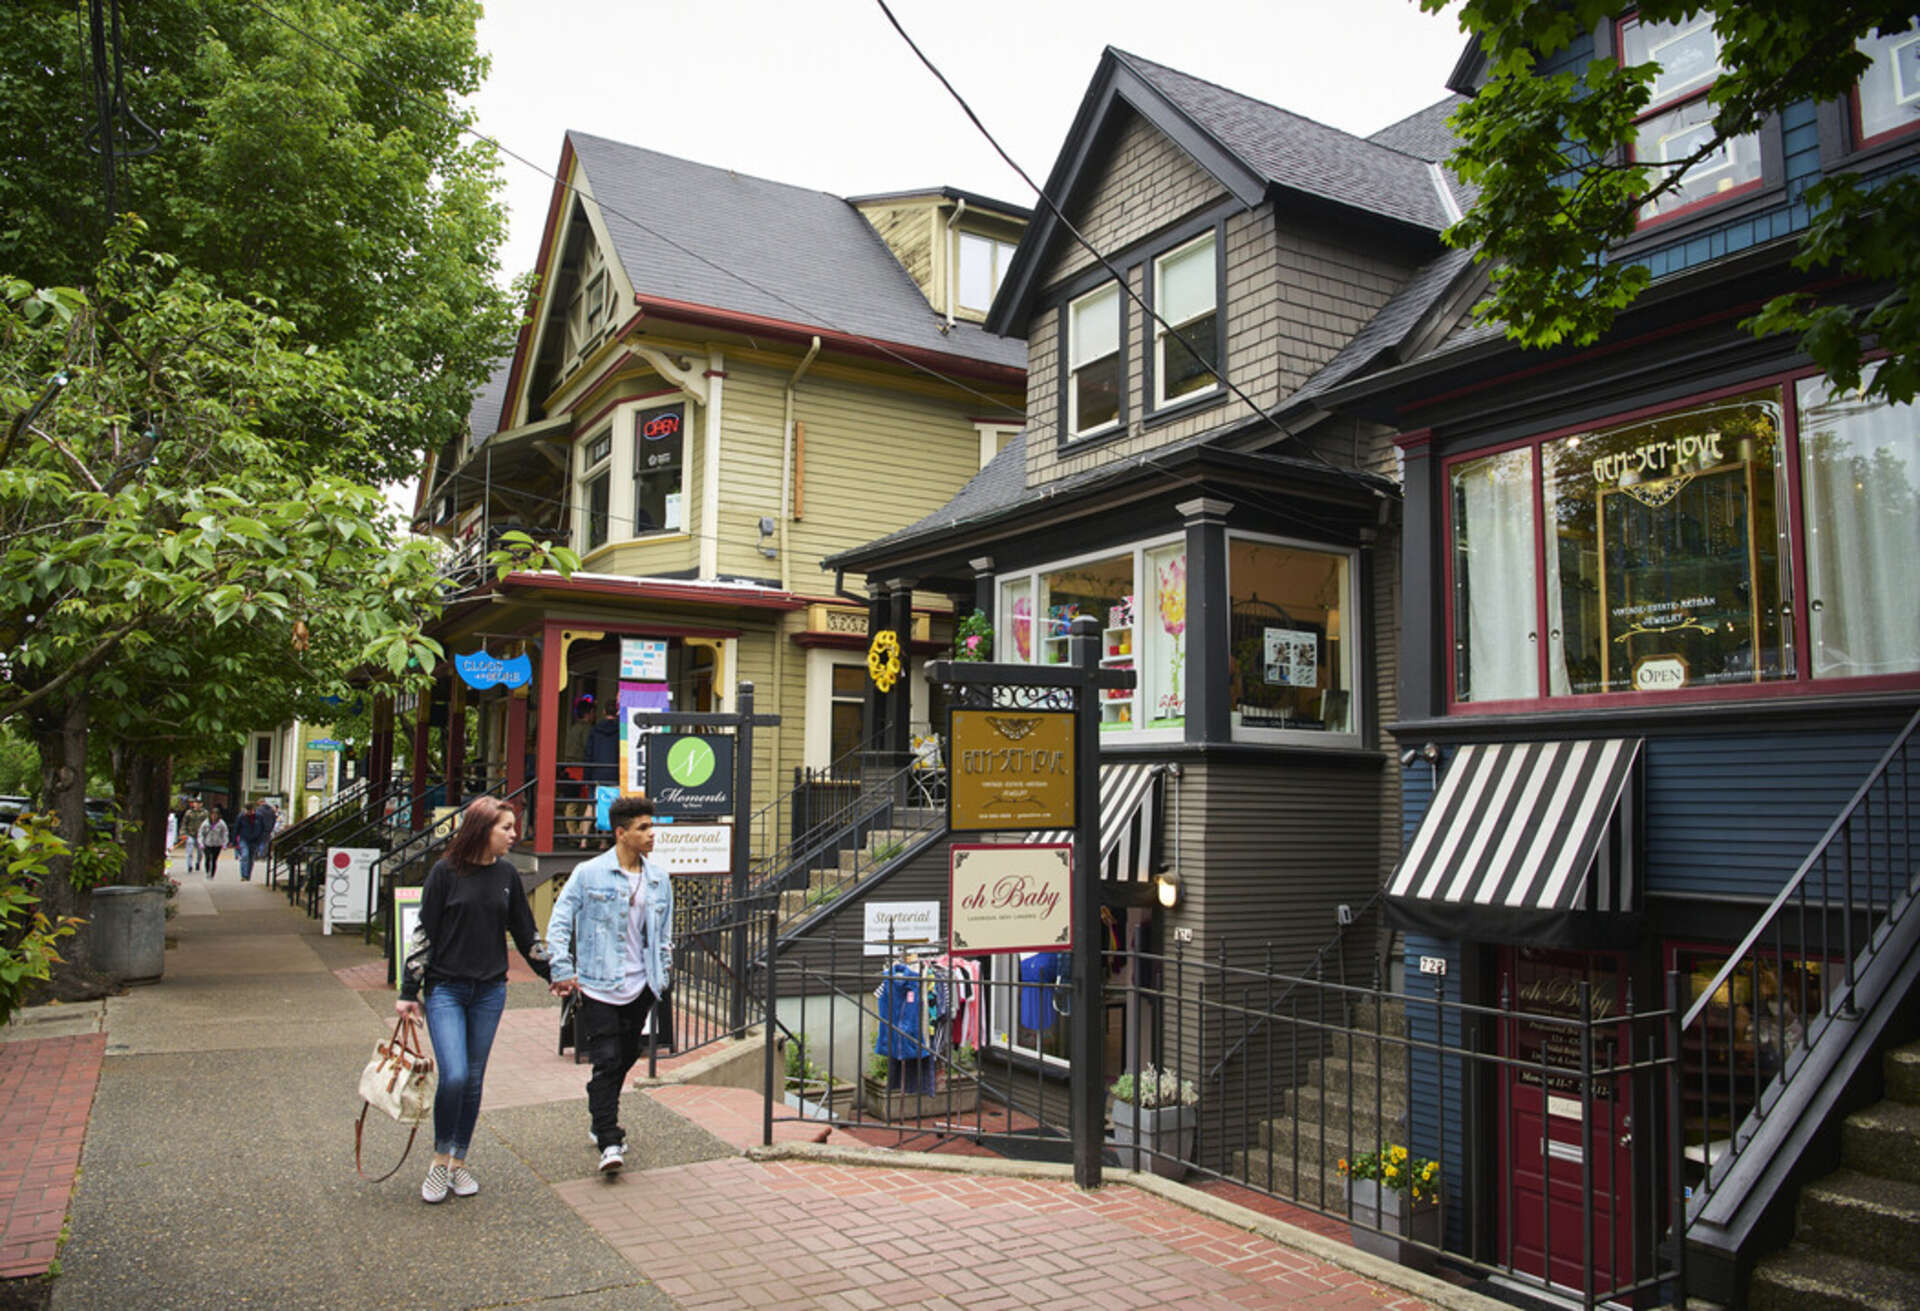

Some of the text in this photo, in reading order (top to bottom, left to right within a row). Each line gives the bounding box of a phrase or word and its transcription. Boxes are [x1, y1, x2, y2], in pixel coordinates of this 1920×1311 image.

[643, 418, 679, 436] OPEN
[1639, 669, 1681, 683] OPEN
[653, 787, 727, 803] Moments
[658, 831, 721, 844] Startorial
[961, 874, 1060, 920] oh Baby
